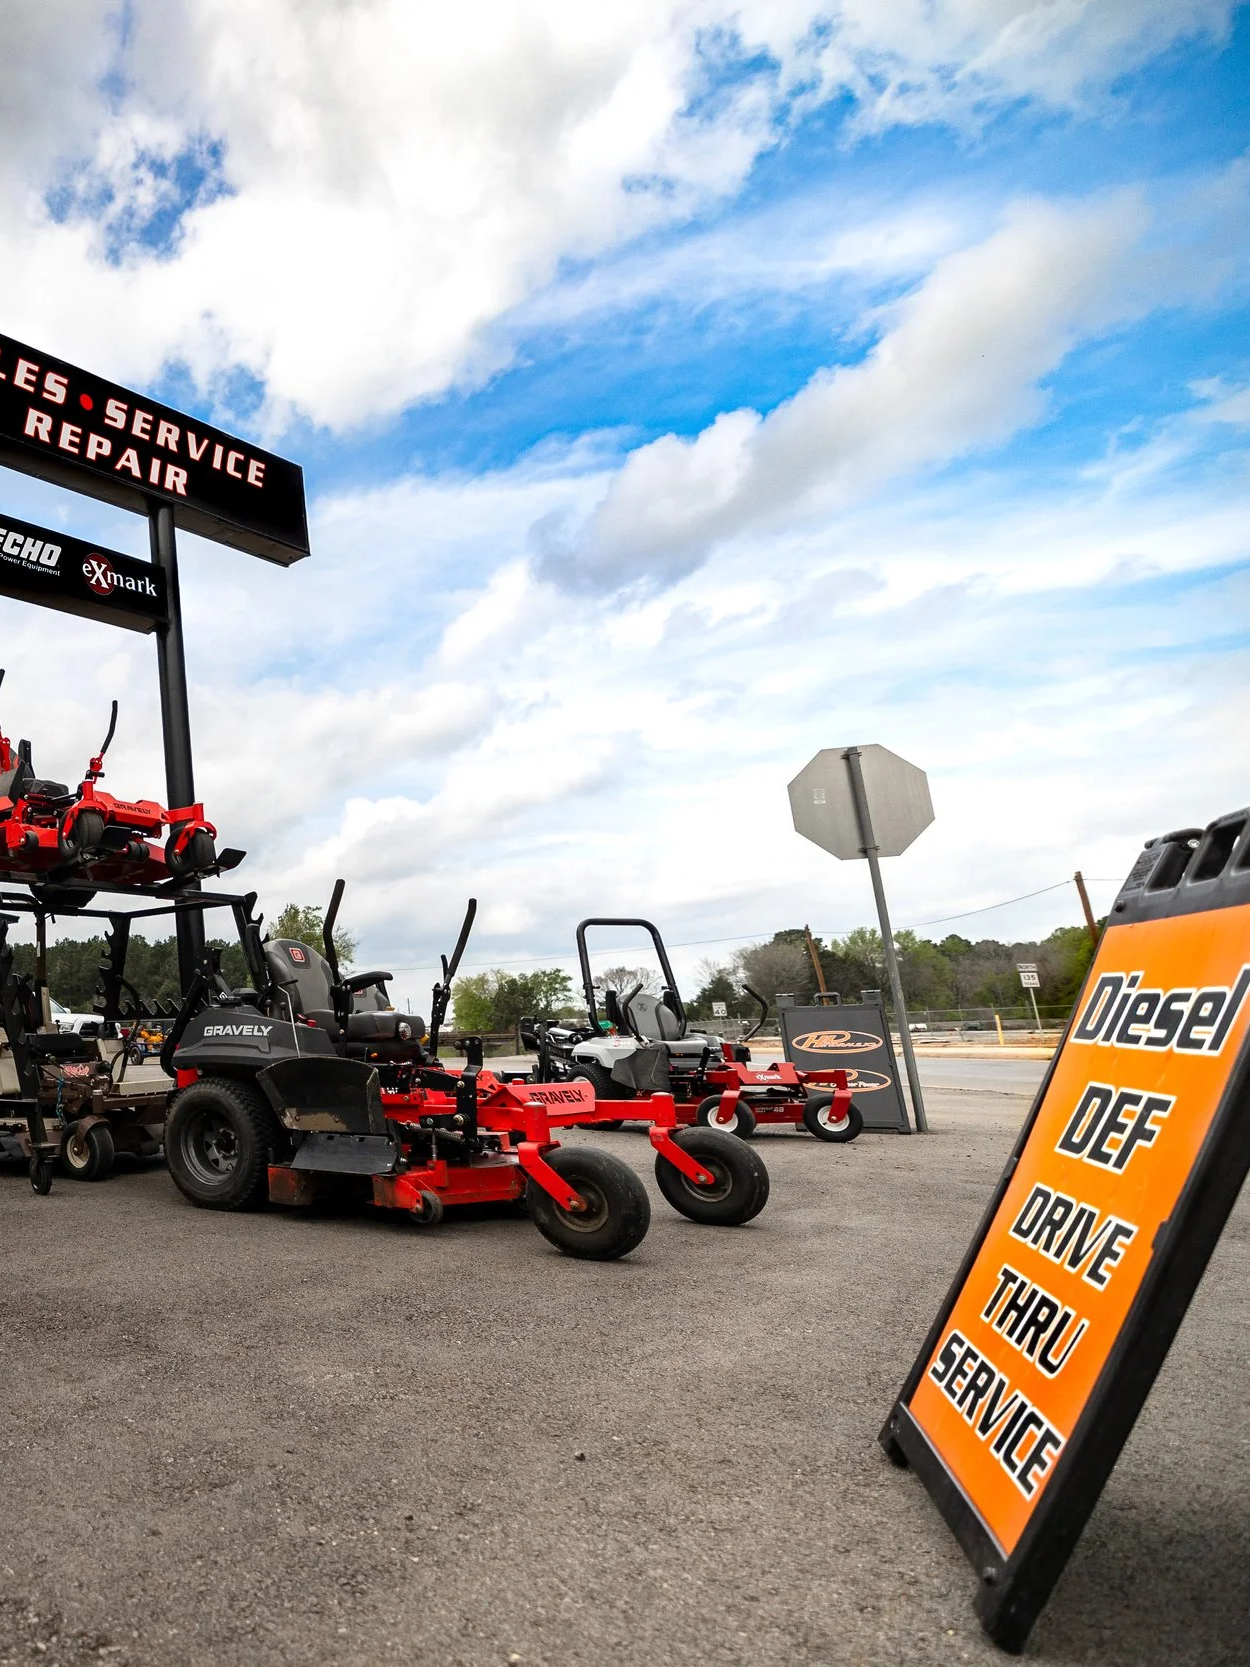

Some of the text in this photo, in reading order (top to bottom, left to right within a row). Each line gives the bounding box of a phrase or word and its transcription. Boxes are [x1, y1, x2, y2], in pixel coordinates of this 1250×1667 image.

[23, 407, 188, 497] REPAIR
[103, 397, 267, 488] SERVICE
[21, 560, 61, 577] Equipment
[82, 559, 158, 597] eXmark
[204, 1024, 273, 1036] GRAVELY
[1070, 962, 1250, 1056] Diesel
[1055, 1081, 1177, 1175] DEF
[1008, 1182, 1138, 1291] DRIVE
[980, 1263, 1090, 1379] THRU
[928, 1329, 1065, 1502] SERVICE
